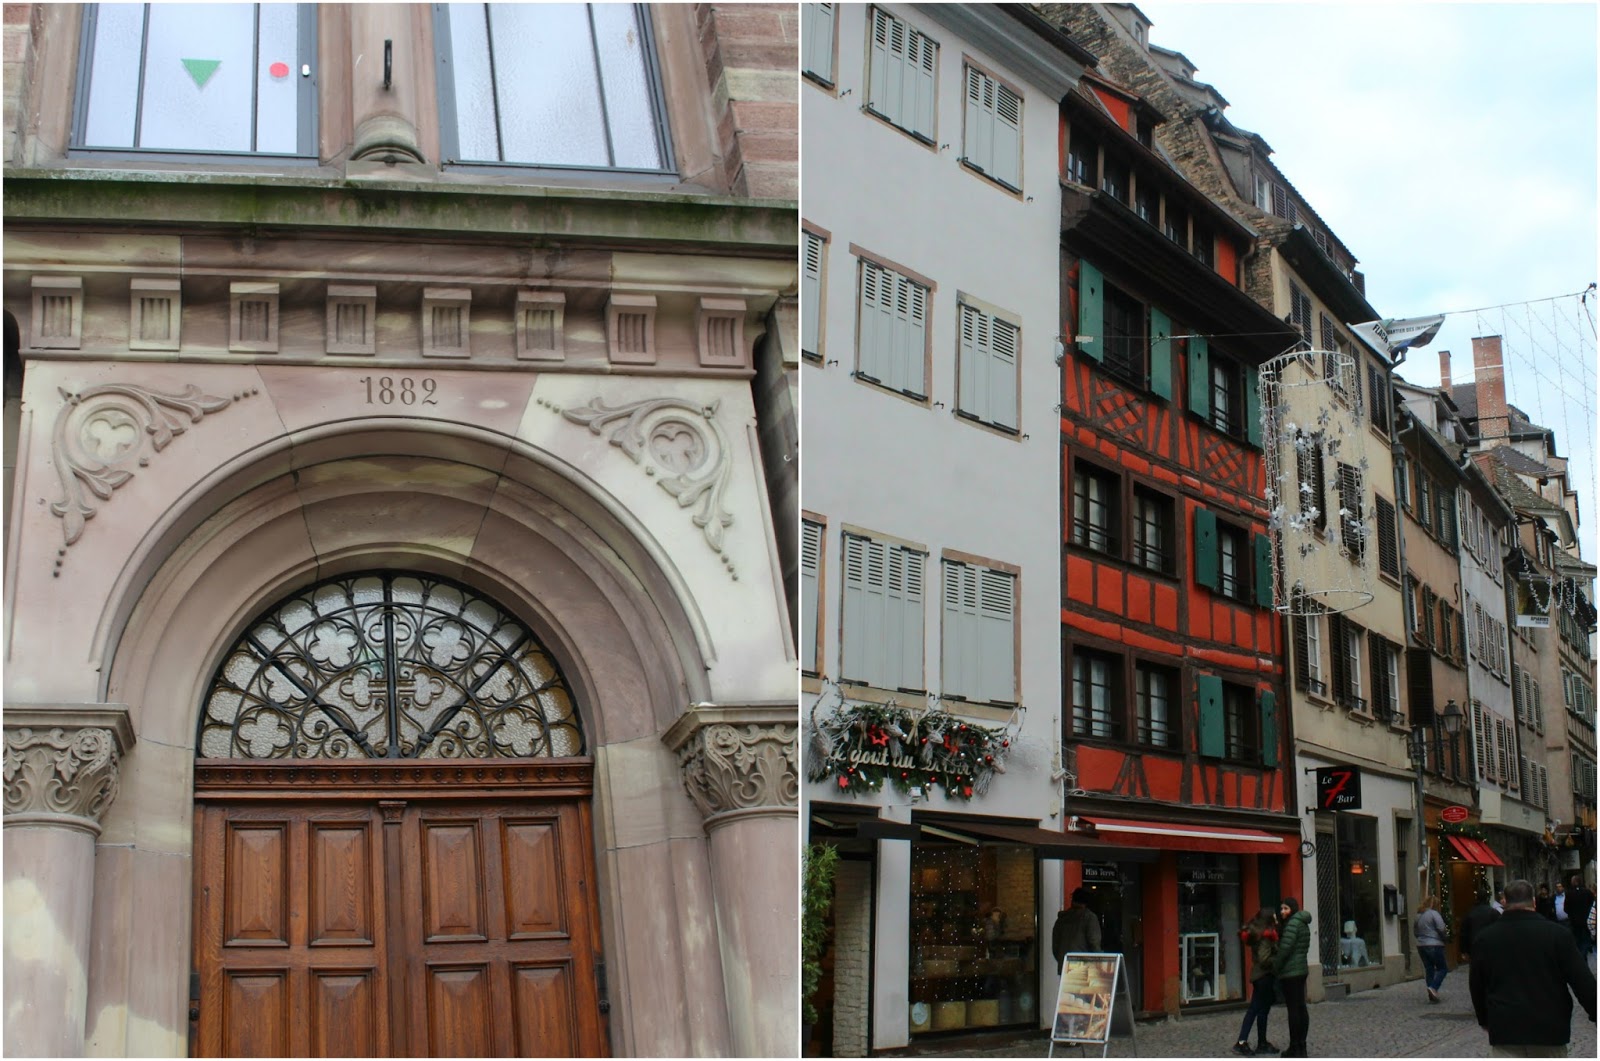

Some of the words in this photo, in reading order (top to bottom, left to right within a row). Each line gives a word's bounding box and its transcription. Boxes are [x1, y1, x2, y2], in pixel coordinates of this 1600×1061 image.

[360, 376, 438, 405] 1882
[1321, 775, 1333, 785] Le
[1325, 771, 1353, 808] 7
[1336, 794, 1355, 803] Bar
